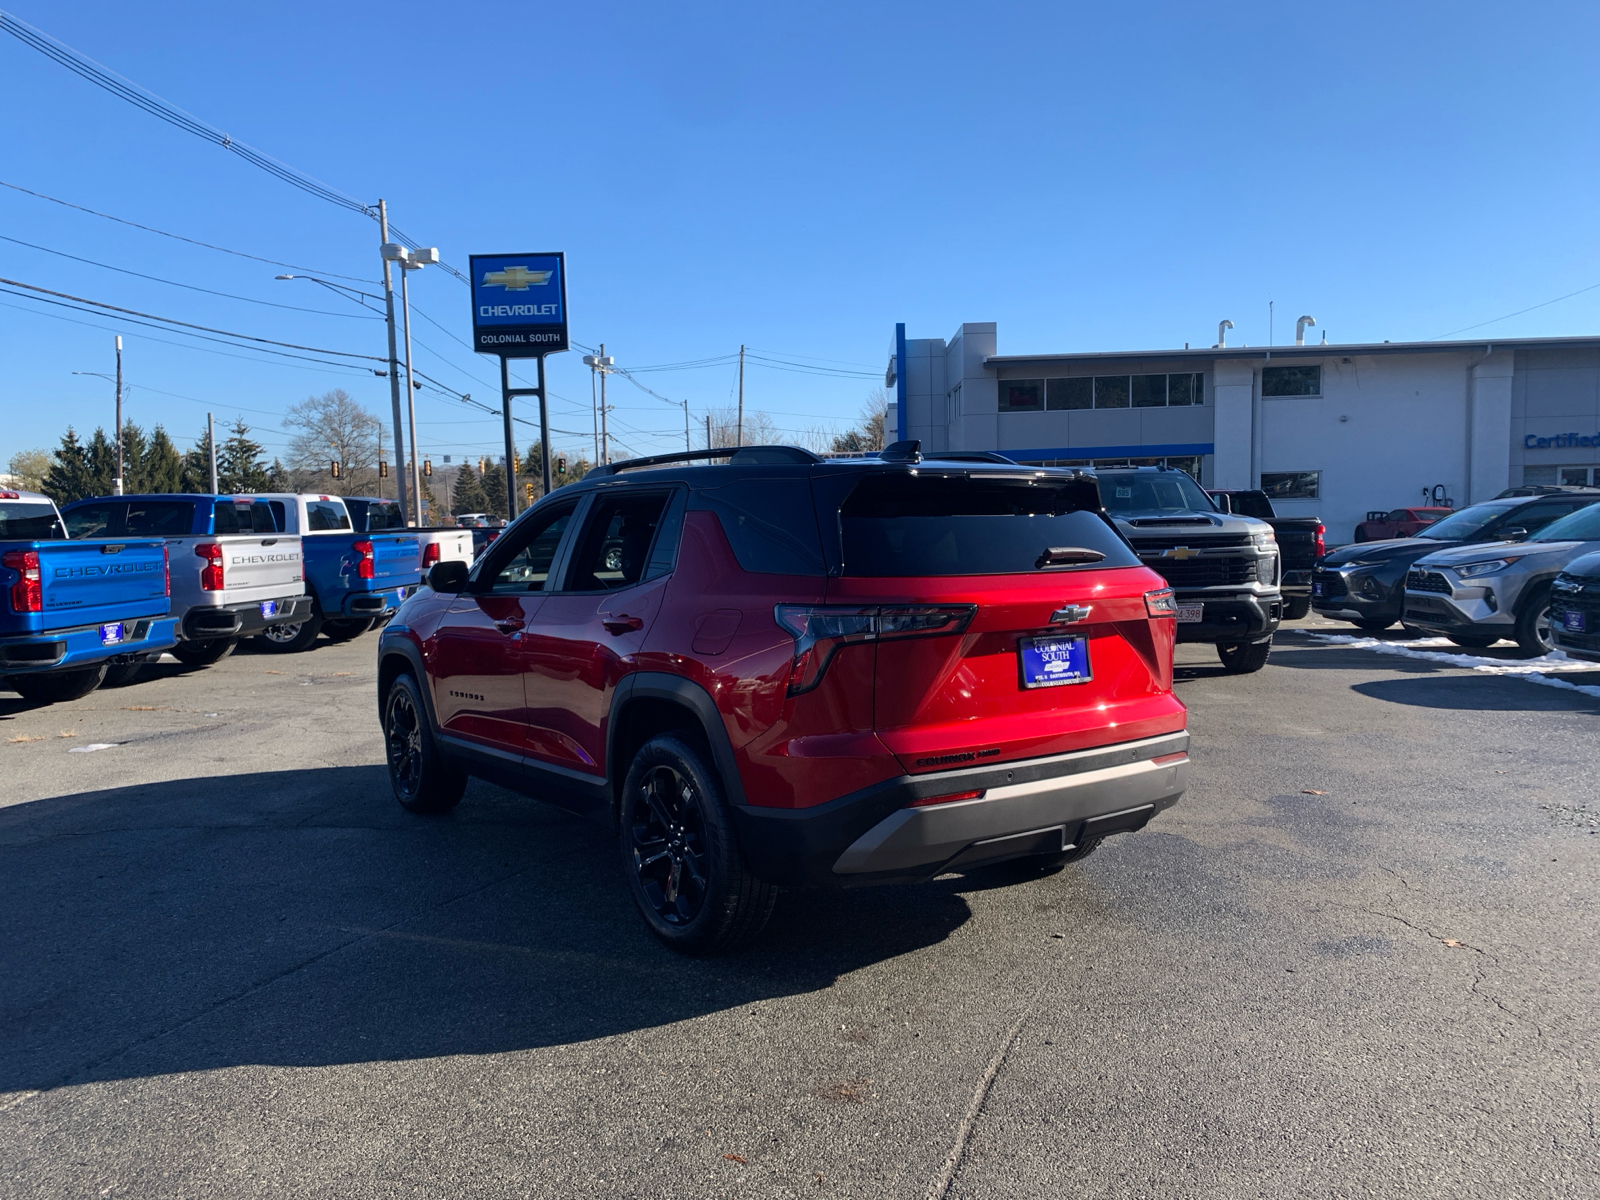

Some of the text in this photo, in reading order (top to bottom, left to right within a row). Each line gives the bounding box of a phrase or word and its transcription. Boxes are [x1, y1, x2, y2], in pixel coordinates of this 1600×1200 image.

[480, 304, 558, 317] CHEVROLET
[481, 333, 560, 344] COLONIAL SOUTH
[1525, 432, 1600, 449] Certified
[1118, 489, 1130, 497] 585
[232, 553, 300, 565] CHEVROLET
[55, 562, 162, 579] CHEVROLET
[1185, 610, 1201, 618] 398
[1035, 642, 1074, 653] COLONIAL
[1042, 651, 1069, 661] SOUTH
